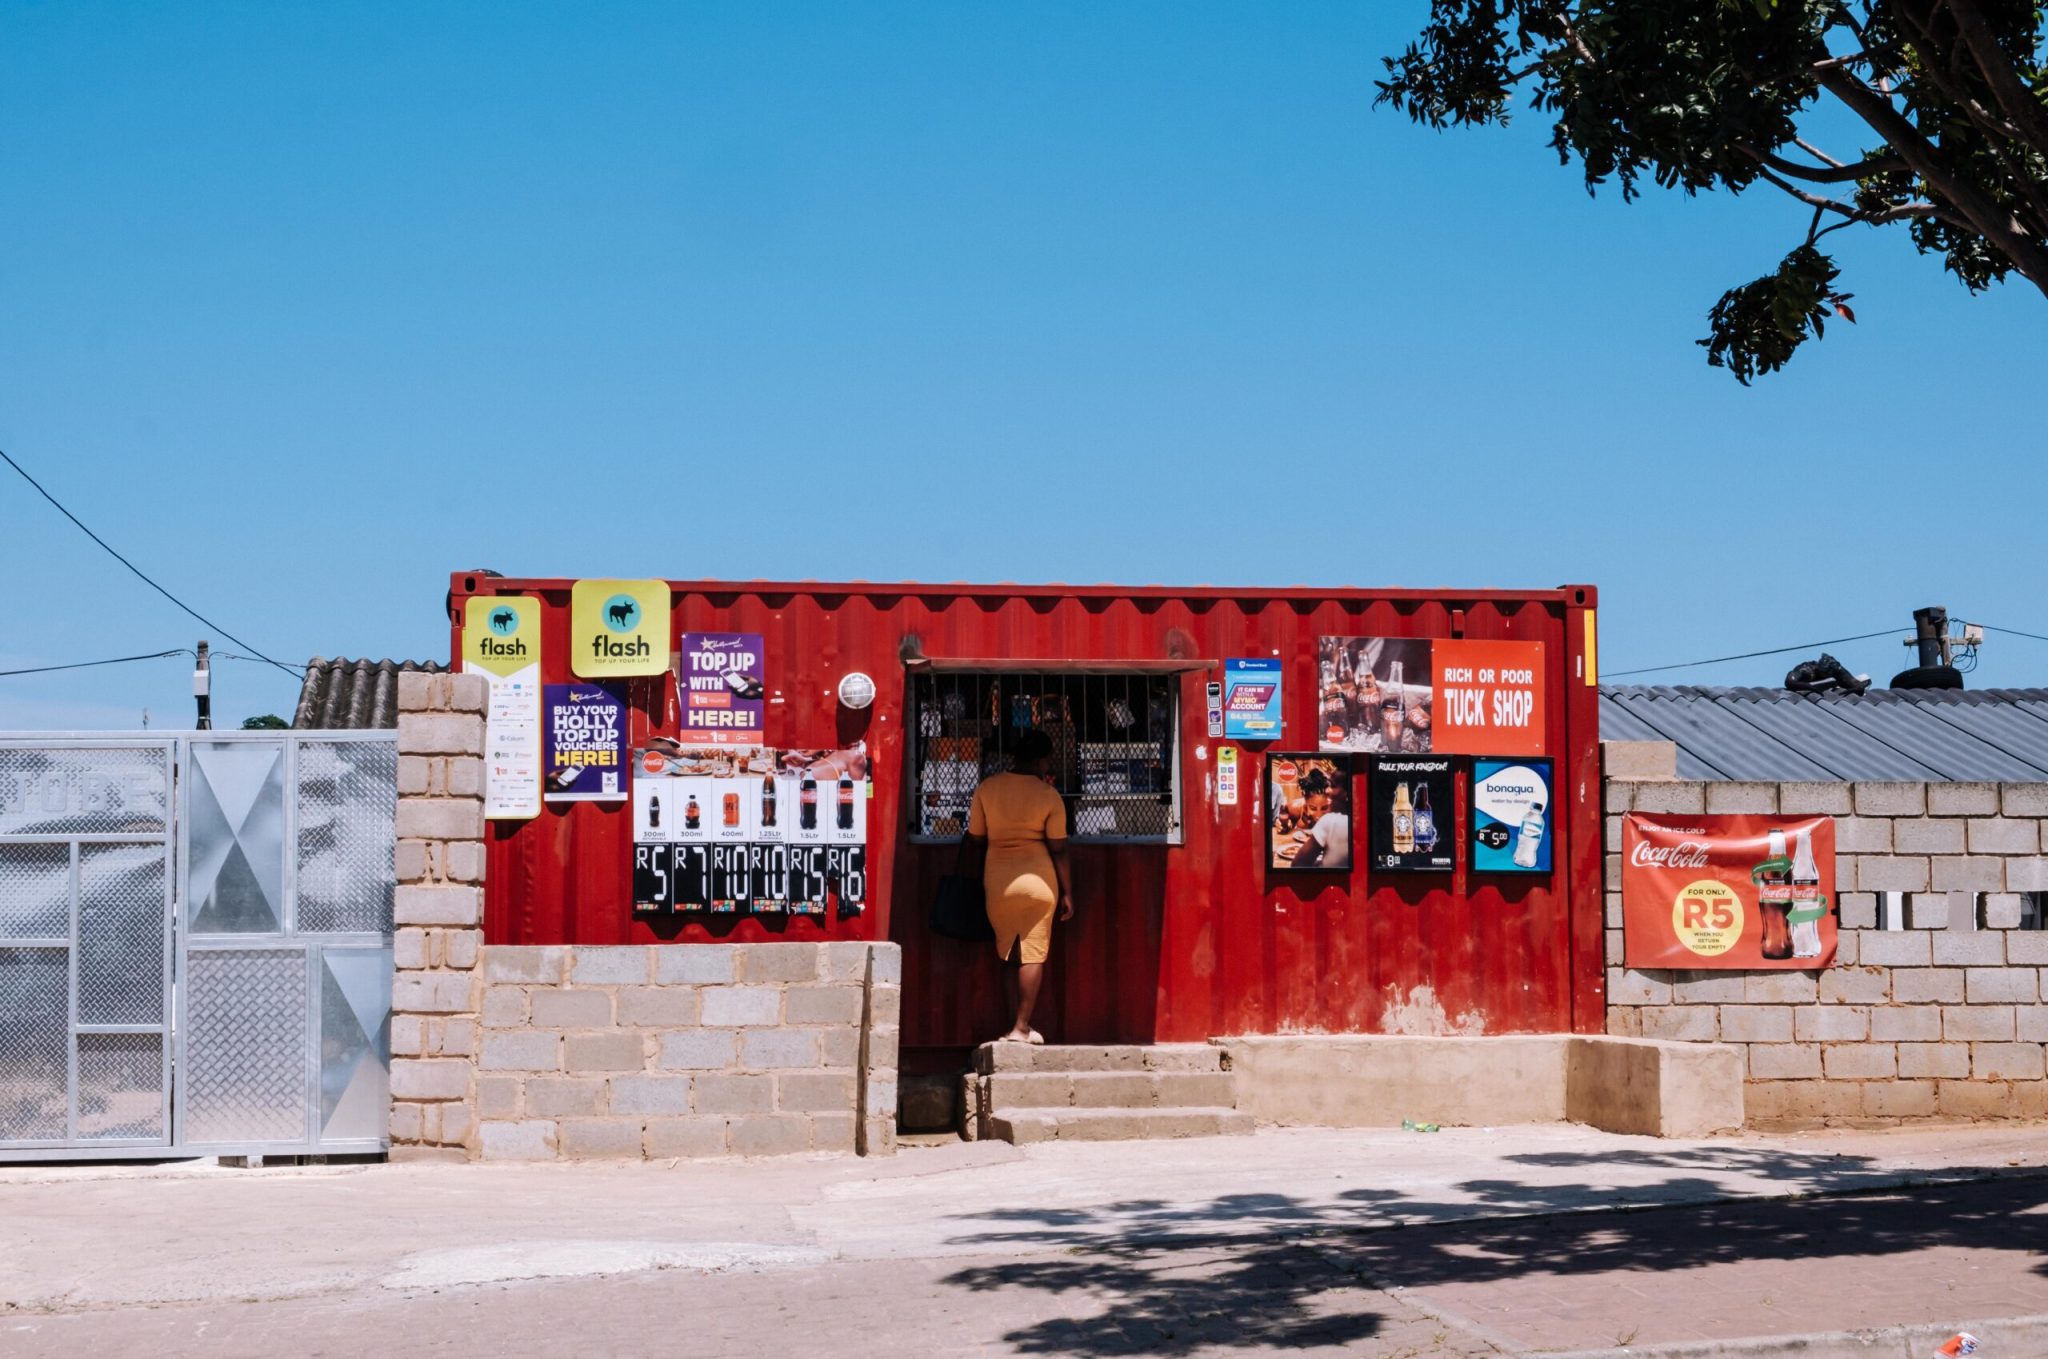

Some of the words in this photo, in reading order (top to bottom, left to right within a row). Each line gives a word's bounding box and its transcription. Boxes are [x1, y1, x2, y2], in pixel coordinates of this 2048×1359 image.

[480, 638, 526, 655] flash
[592, 634, 649, 656] flash
[690, 652, 727, 671] TOP
[729, 652, 755, 671] UP
[689, 676, 723, 690] WITH
[1444, 668, 1472, 683] RICH
[1479, 669, 1495, 683] OR
[1501, 669, 1533, 684] POOR
[554, 706, 580, 715] BUY
[582, 705, 617, 715] YOUR
[1444, 688, 1485, 726] TUCK
[1493, 689, 1533, 727] SHOP
[554, 715, 616, 729] HOLLY
[688, 710, 755, 727] HERE!
[554, 729, 590, 742] TOP
[594, 729, 619, 742] UP
[555, 742, 618, 750] VOUCHERS
[555, 751, 618, 766] HERE!
[1379, 762, 1396, 771] RULE
[1396, 762, 1415, 772] YOUR
[1486, 784, 1533, 795] bonaqua
[1631, 840, 1712, 869] Coca-Cola
[1682, 898, 1735, 929] R5
